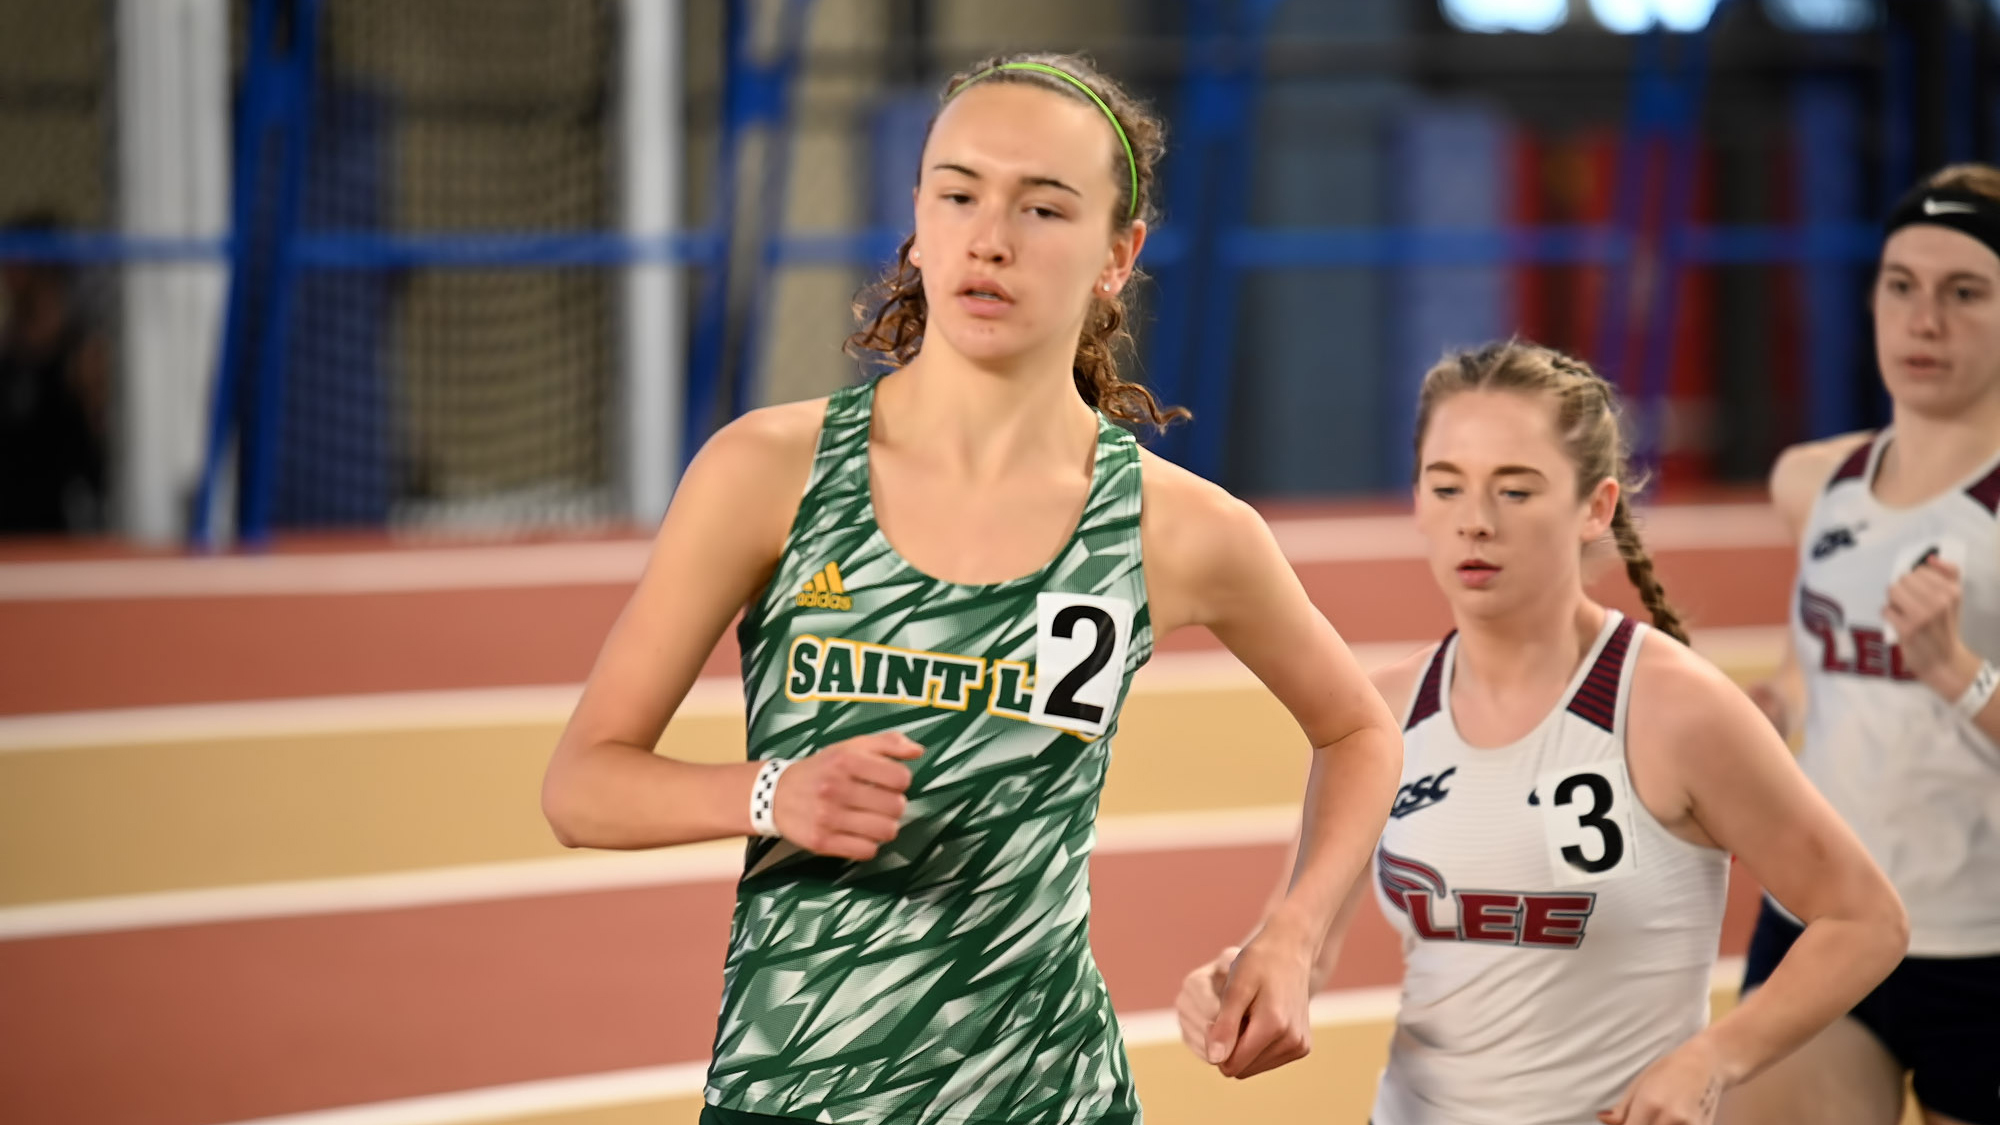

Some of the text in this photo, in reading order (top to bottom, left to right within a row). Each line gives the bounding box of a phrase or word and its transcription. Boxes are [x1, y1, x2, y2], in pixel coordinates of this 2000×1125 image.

[796, 590, 852, 611] adidas
[786, 635, 987, 711] SAINT
[1044, 605, 1116, 724] 2
[1554, 773, 1624, 873] 3
[1402, 889, 1597, 949] LEE
